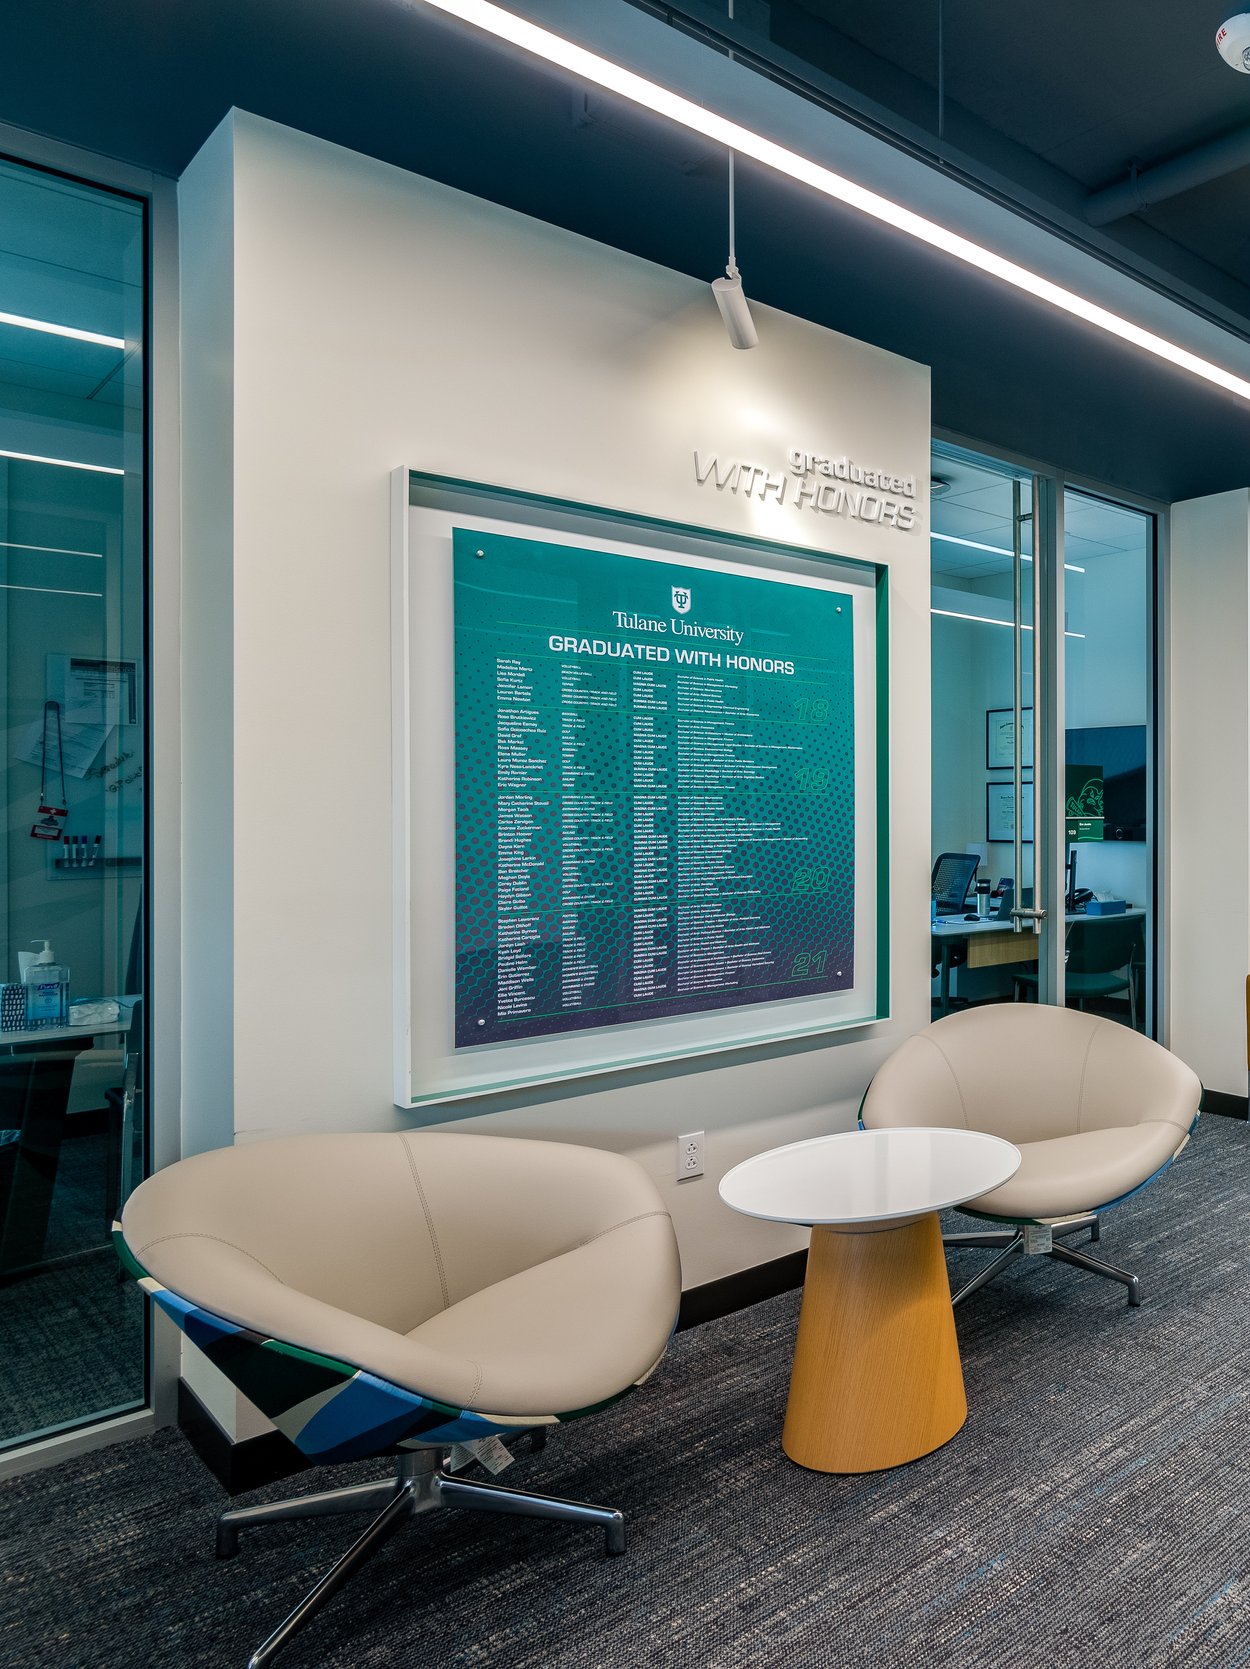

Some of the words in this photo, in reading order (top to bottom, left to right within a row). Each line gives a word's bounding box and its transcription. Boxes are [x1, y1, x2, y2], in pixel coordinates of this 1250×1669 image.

[789, 449, 917, 498] graduated
[693, 450, 786, 500] WITH
[794, 479, 918, 529] HONORS
[612, 611, 668, 633] Tulane
[671, 618, 744, 646] University
[548, 634, 670, 662] GRADUATED
[675, 648, 721, 668] WITH
[726, 655, 795, 675] HONORS
[793, 698, 829, 721] 18
[793, 767, 830, 791] 19
[792, 866, 830, 891] 20
[792, 951, 828, 977] 21
